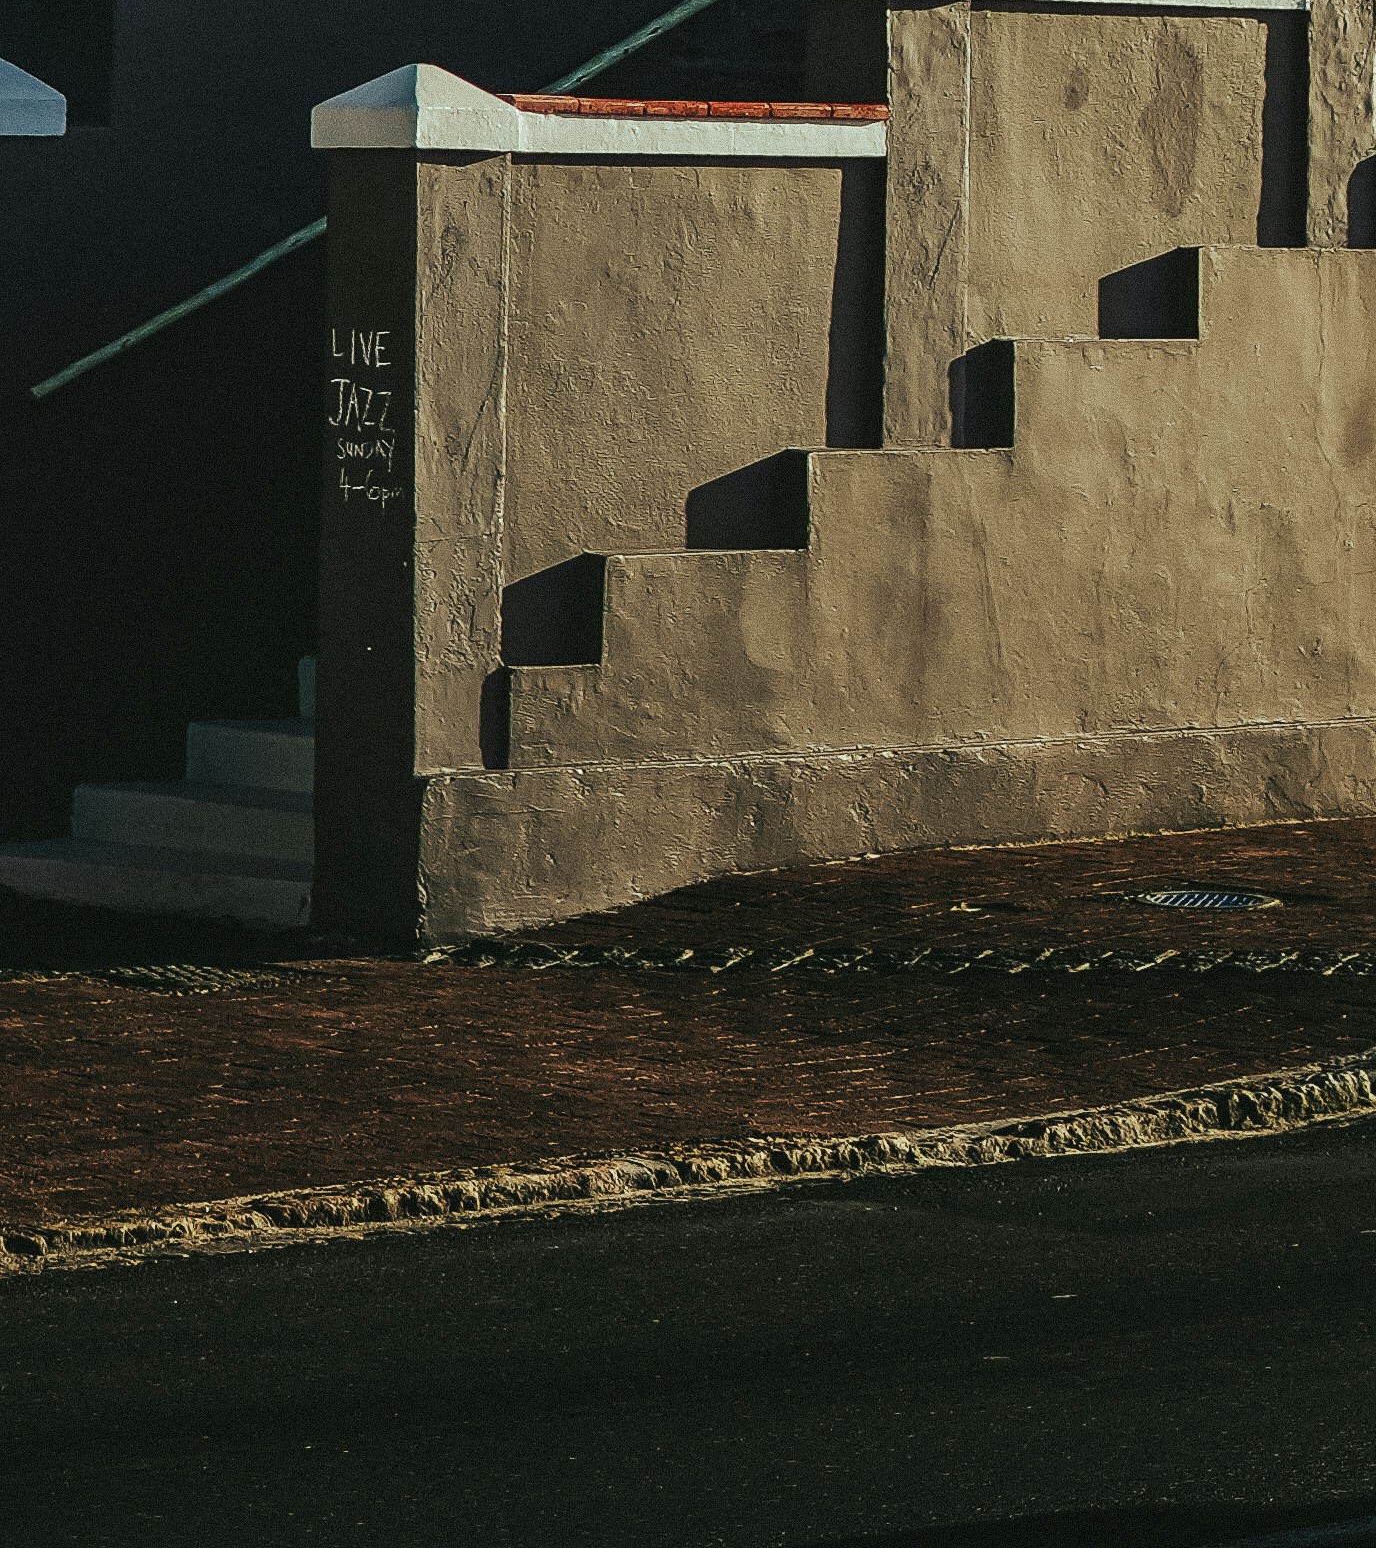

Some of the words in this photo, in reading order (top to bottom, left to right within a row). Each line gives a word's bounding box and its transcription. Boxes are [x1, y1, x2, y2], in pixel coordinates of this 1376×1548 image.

[331, 328, 392, 368] LIVE
[328, 378, 396, 433] JAZZ
[337, 437, 396, 473] SUNDAY
